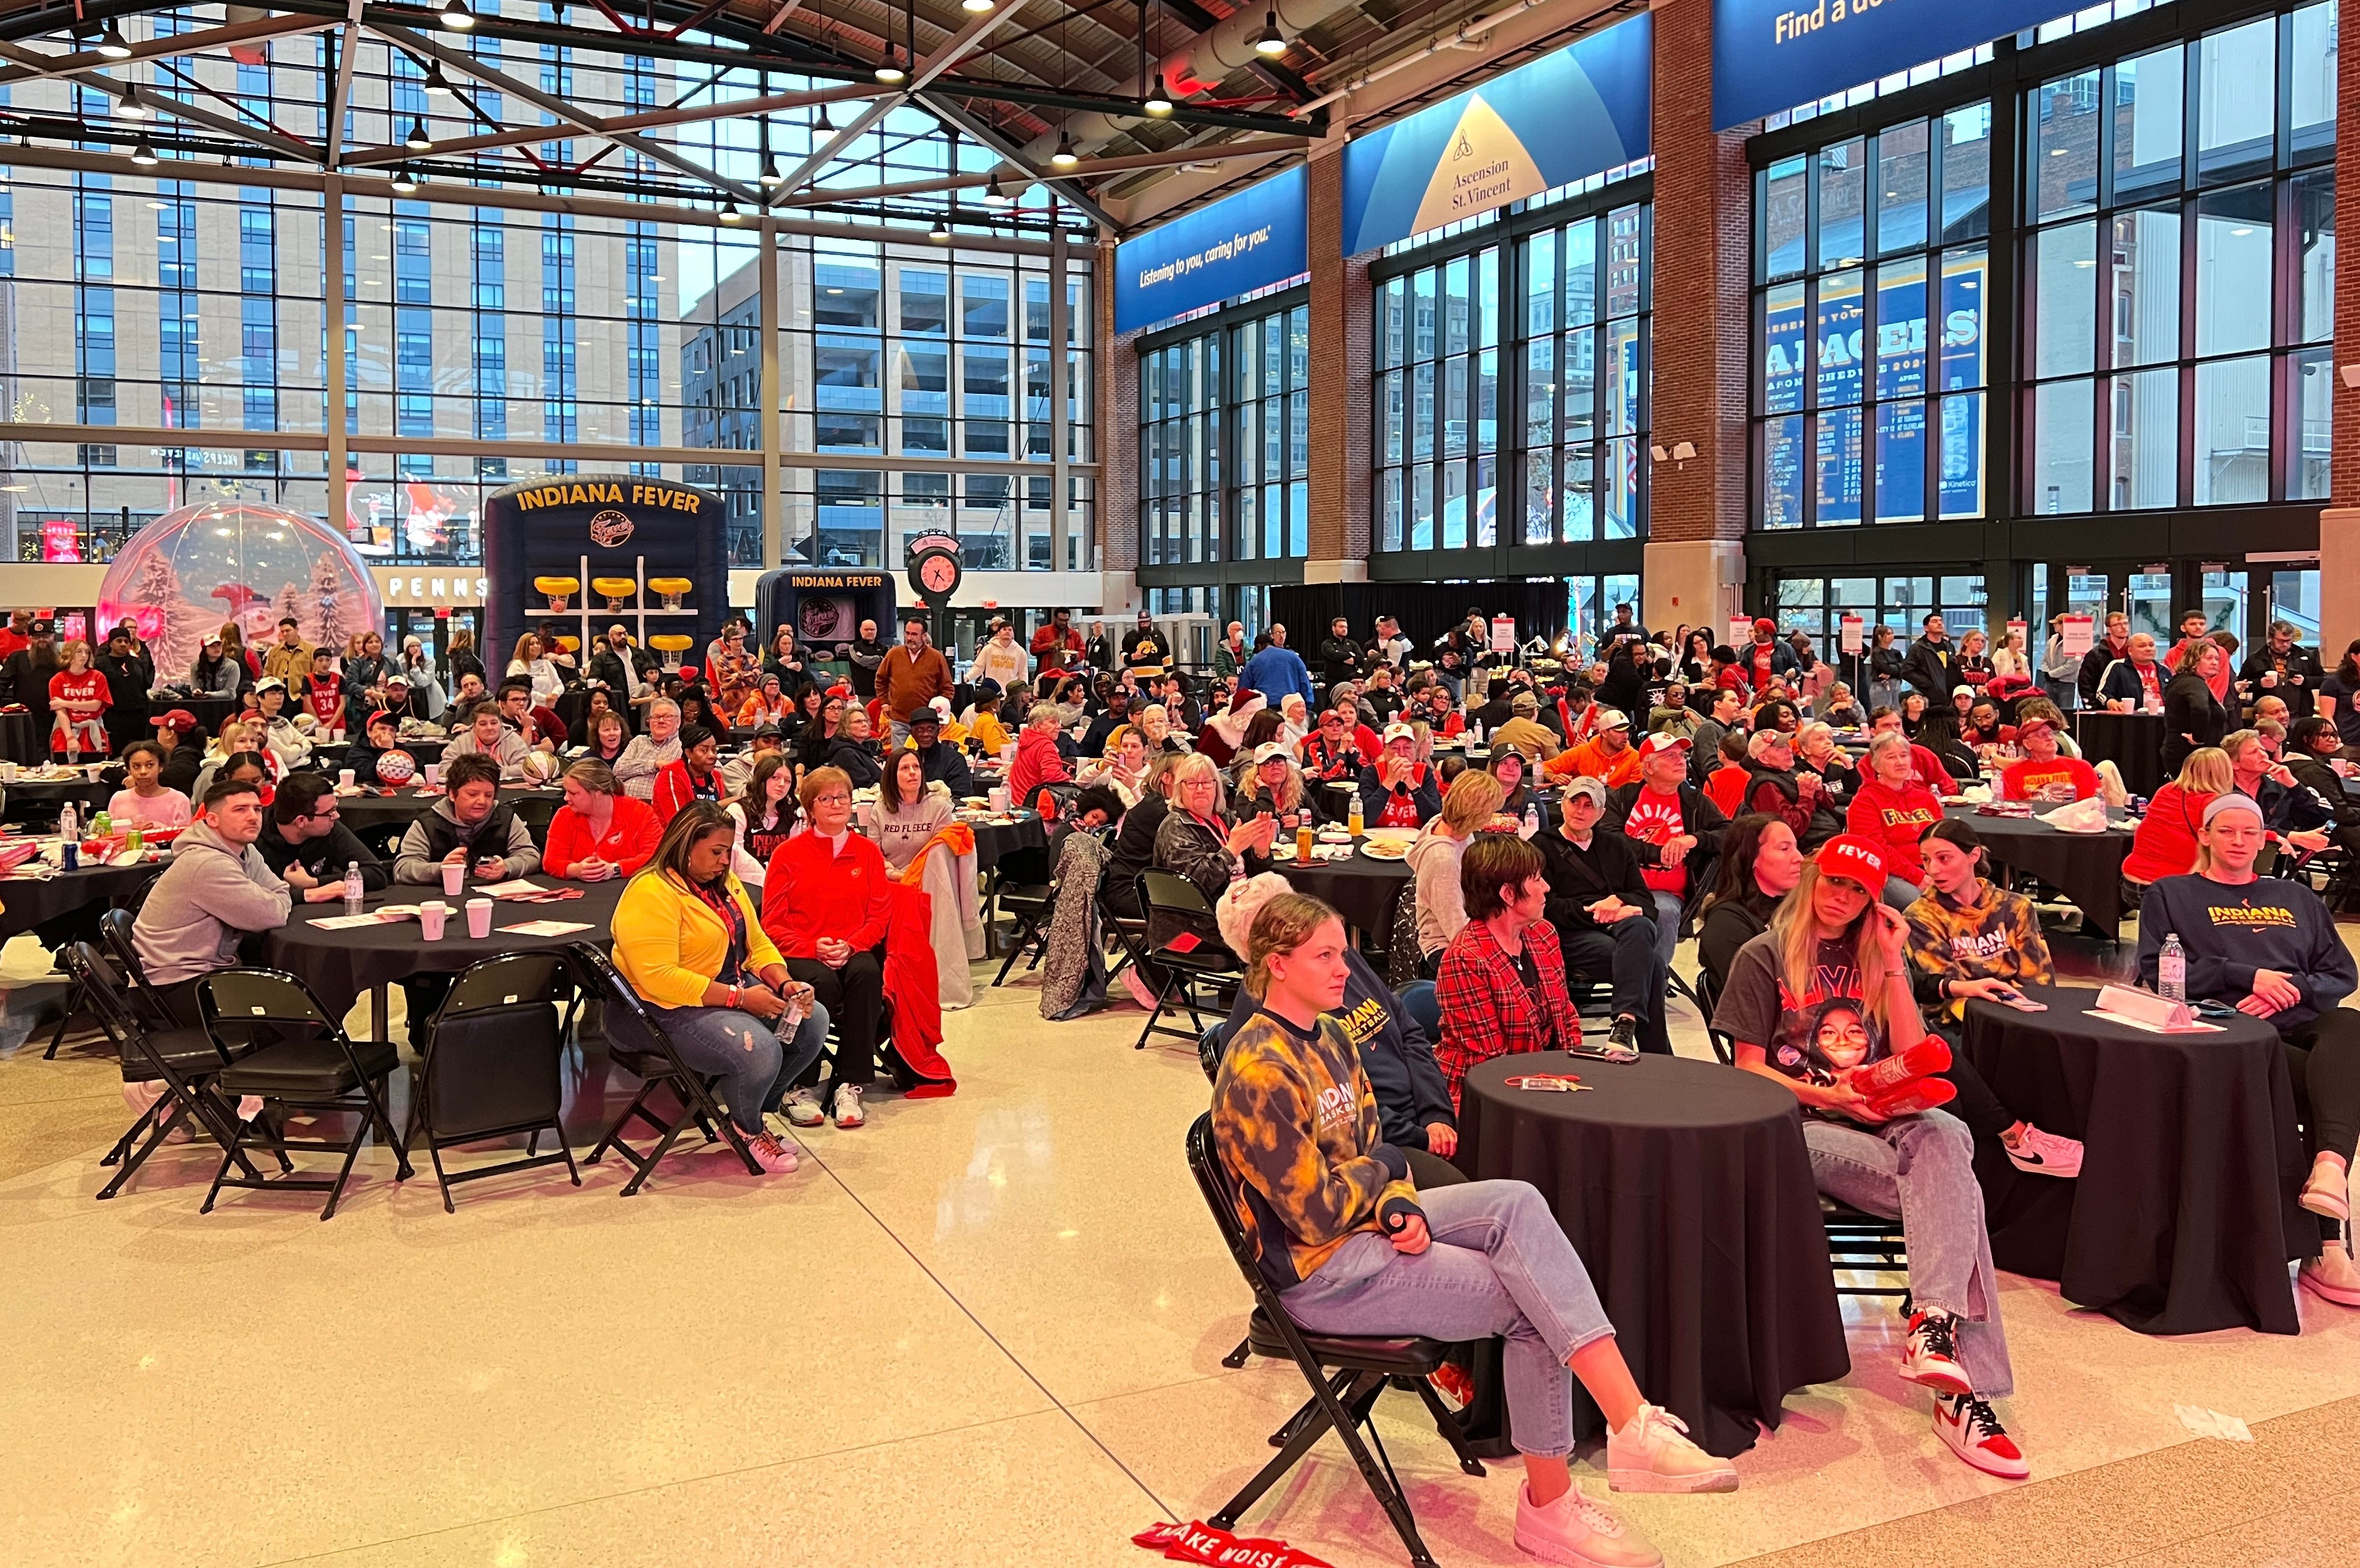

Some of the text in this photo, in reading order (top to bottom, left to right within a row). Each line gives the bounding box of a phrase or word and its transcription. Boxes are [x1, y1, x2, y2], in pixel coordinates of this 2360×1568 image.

[1775, 0, 1825, 44] Find
[1831, 0, 1846, 22] a
[1452, 160, 1508, 190] Ascension
[1452, 177, 1512, 210] St. Vincent
[1140, 263, 1174, 288] Listening
[1176, 258, 1184, 274] to
[1185, 254, 1203, 274] you,
[1205, 241, 1233, 263] caring
[1233, 233, 1248, 257] for
[516, 484, 700, 514] INDIANA FEVER
[792, 576, 882, 587] INDIANA FEVER
[64, 687, 95, 697] FEVER
[315, 689, 336, 698] FEVER
[319, 698, 335, 711] 34
[884, 823, 932, 833] RED FLEECE
[1881, 808, 1936, 827] FEVER
[1837, 844, 1882, 871] FEVER
[2207, 906, 2294, 919] INDIANA
[2211, 915, 2296, 924] BASKETBALL
[1338, 997, 1382, 1033] DIANA
[1155, 1524, 1289, 1568] MAKE NOISE
